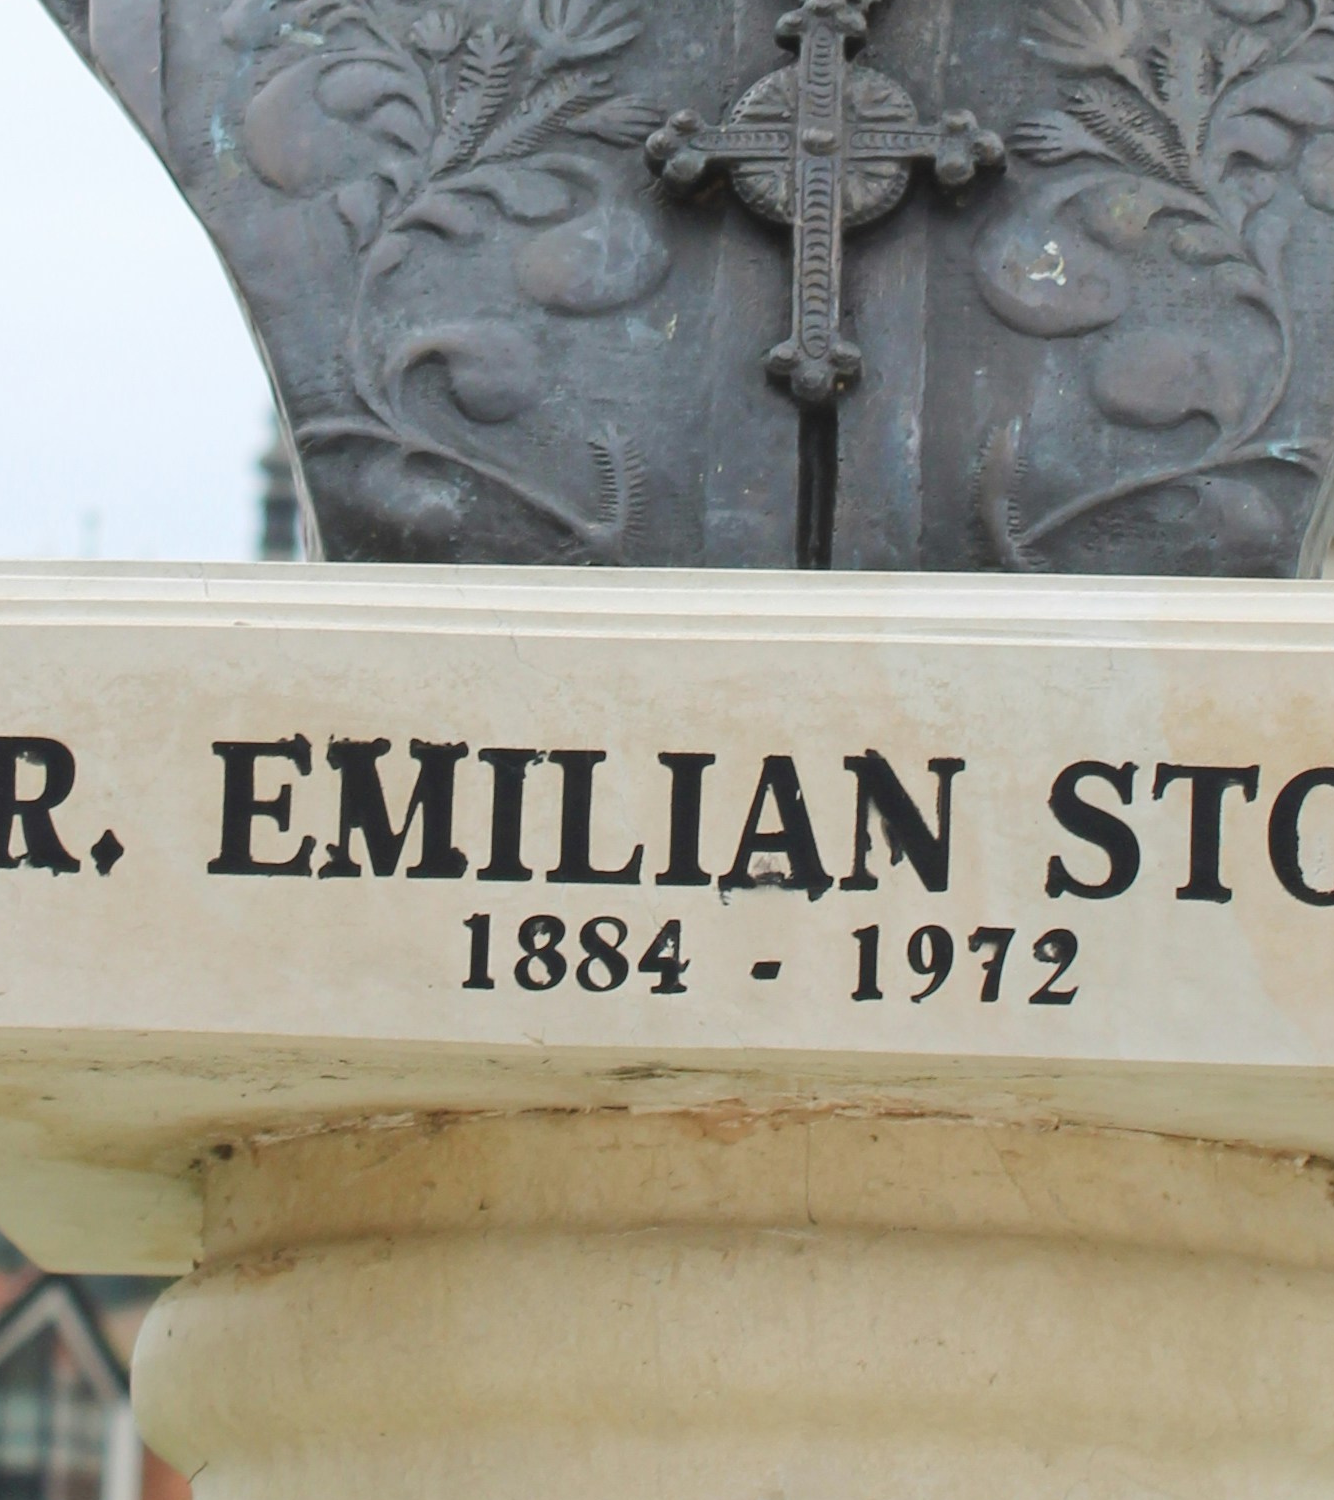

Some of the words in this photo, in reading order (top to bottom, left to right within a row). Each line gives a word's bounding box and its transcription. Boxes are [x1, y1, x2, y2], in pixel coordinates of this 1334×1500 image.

[206, 731, 967, 904] EMILIAN
[460, 912, 691, 996] 1884
[850, 923, 1080, 1006] 1972
